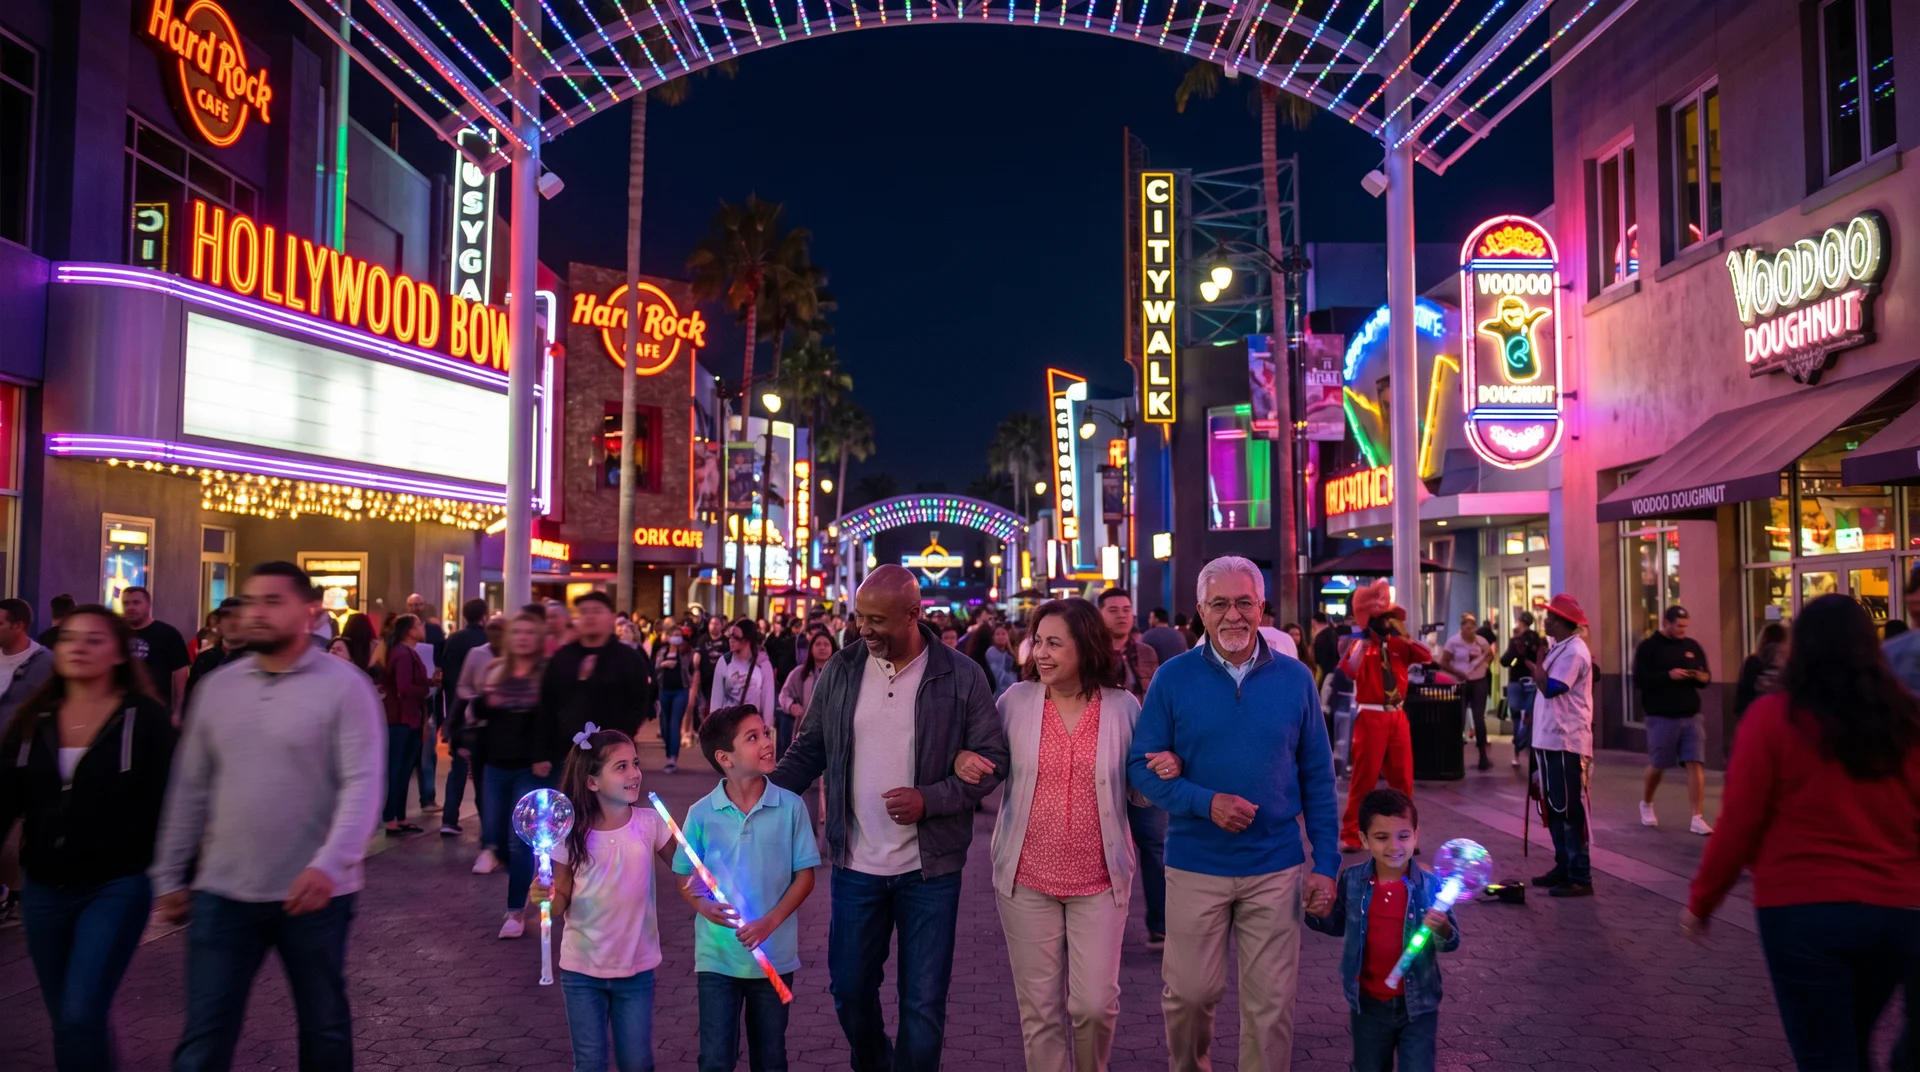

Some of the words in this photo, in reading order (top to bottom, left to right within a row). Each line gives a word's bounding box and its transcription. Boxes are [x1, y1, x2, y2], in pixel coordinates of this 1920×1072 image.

[148, 0, 217, 75] Hard
[216, 41, 273, 124] Rock
[196, 88, 230, 123] CAFE
[193, 200, 440, 349] HOLLYWOOD
[450, 294, 513, 373] BOW
[1478, 273, 1552, 295] VOODOO
[1725, 216, 1880, 326] VOODOO
[1143, 179, 1175, 416] CITYWALK
[643, 303, 707, 348] Rock
[1744, 288, 1863, 363] DOUGHNUT
[622, 342, 661, 359] AFE
[1478, 384, 1555, 404] DOUGHNUT
[1631, 494, 1670, 516] VOODOO
[1671, 484, 1726, 510] DOUGHNUT
[671, 529, 704, 549] CAFE
